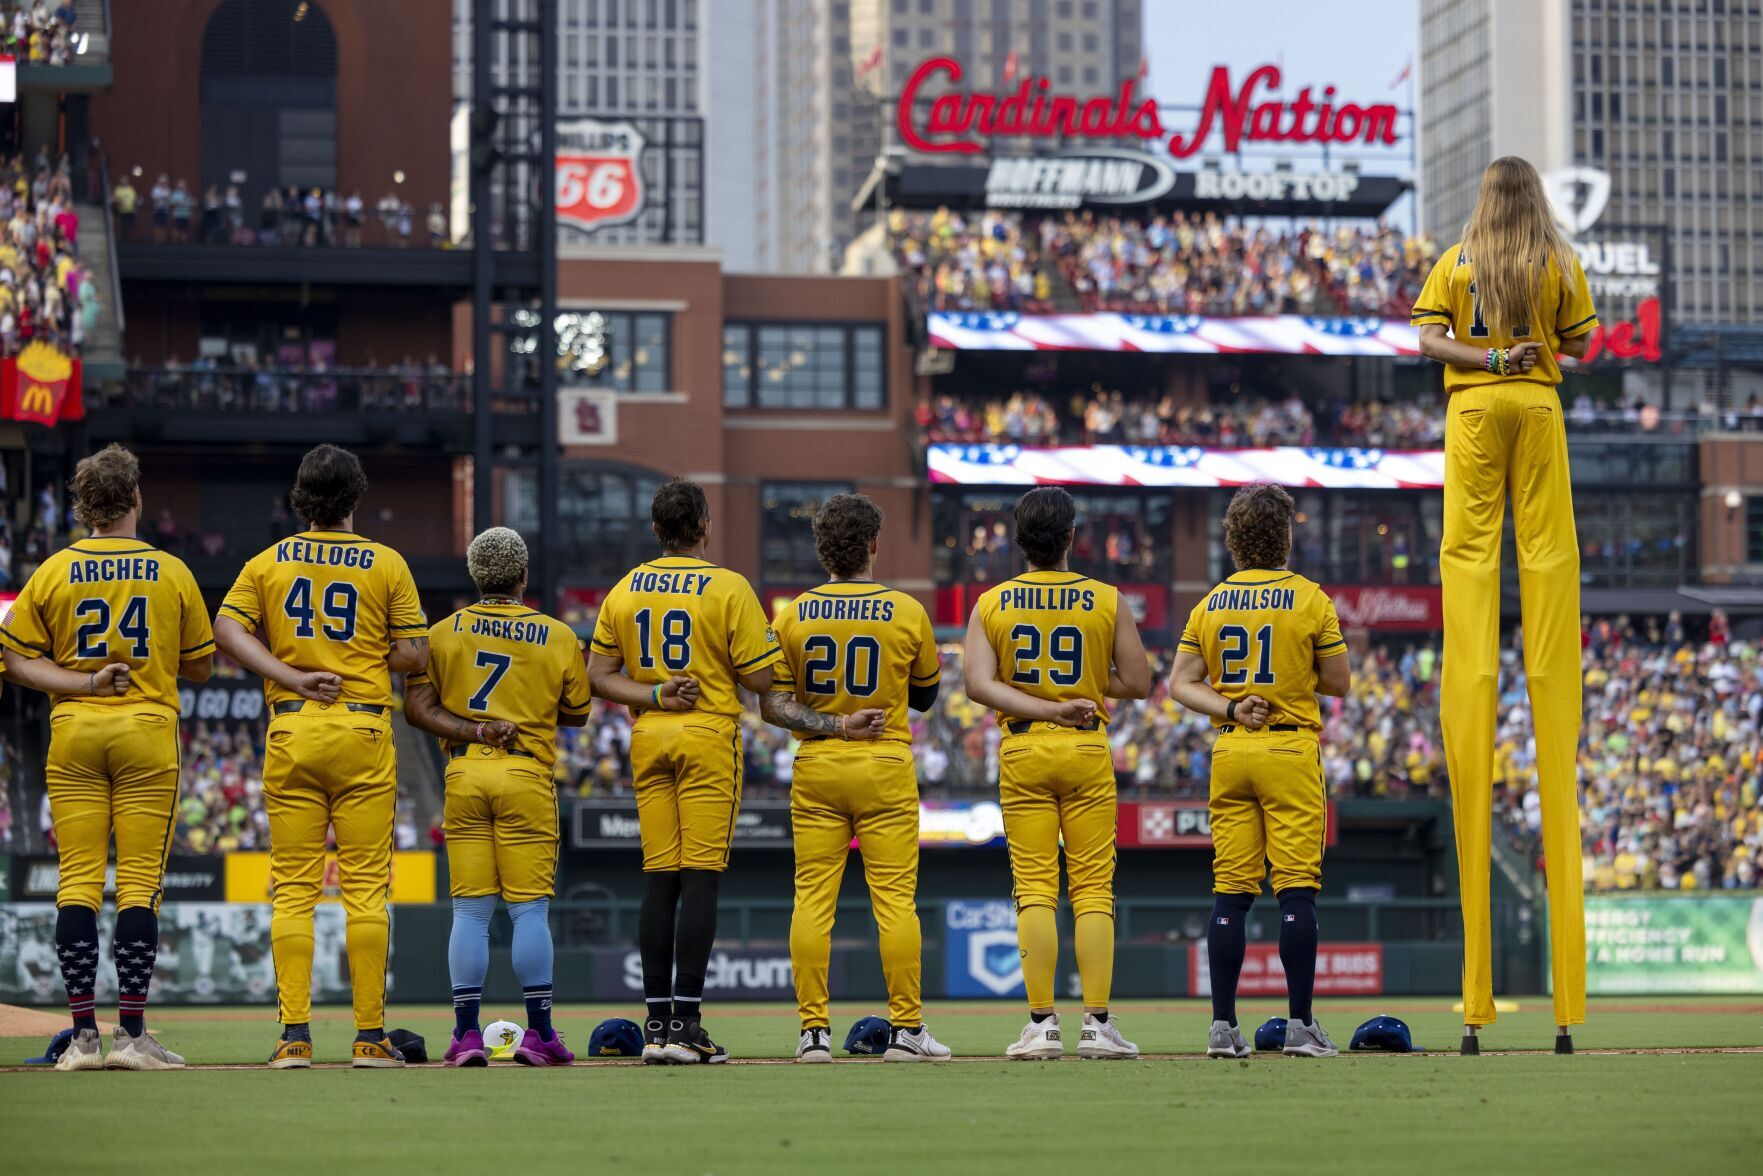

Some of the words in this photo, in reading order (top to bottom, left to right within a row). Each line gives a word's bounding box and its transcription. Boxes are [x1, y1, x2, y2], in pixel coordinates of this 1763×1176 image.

[899, 57, 1164, 154] Cardinals
[1168, 65, 1400, 159] Nation
[557, 132, 630, 151] HILLIPS
[556, 162, 628, 209] 66
[985, 157, 1144, 195] HOFFMANN
[1194, 172, 1359, 201] ROOFTOP
[69, 558, 160, 584] ARCHER
[277, 541, 375, 571] KELLOGG
[630, 571, 712, 597] HOSLEY
[1000, 587, 1095, 612] PHILLIPS
[1207, 588, 1295, 612] DONALSON
[283, 576, 359, 642] 49
[799, 599, 894, 623] VOORHEES
[75, 596, 151, 659] 24
[471, 617, 549, 646] JACKSON
[635, 607, 692, 671] 18
[803, 634, 881, 697] 20
[1010, 623, 1084, 687] 29
[1218, 624, 1275, 686] 21
[468, 650, 512, 712] 7
[197, 687, 230, 719] GO
[231, 688, 264, 719] GO
[1585, 927, 1691, 945] FFICIENCY
[1596, 946, 1612, 963] A
[1616, 946, 1676, 963] HOME
[1681, 946, 1726, 963] RUN
[623, 952, 793, 990] Sctrum
